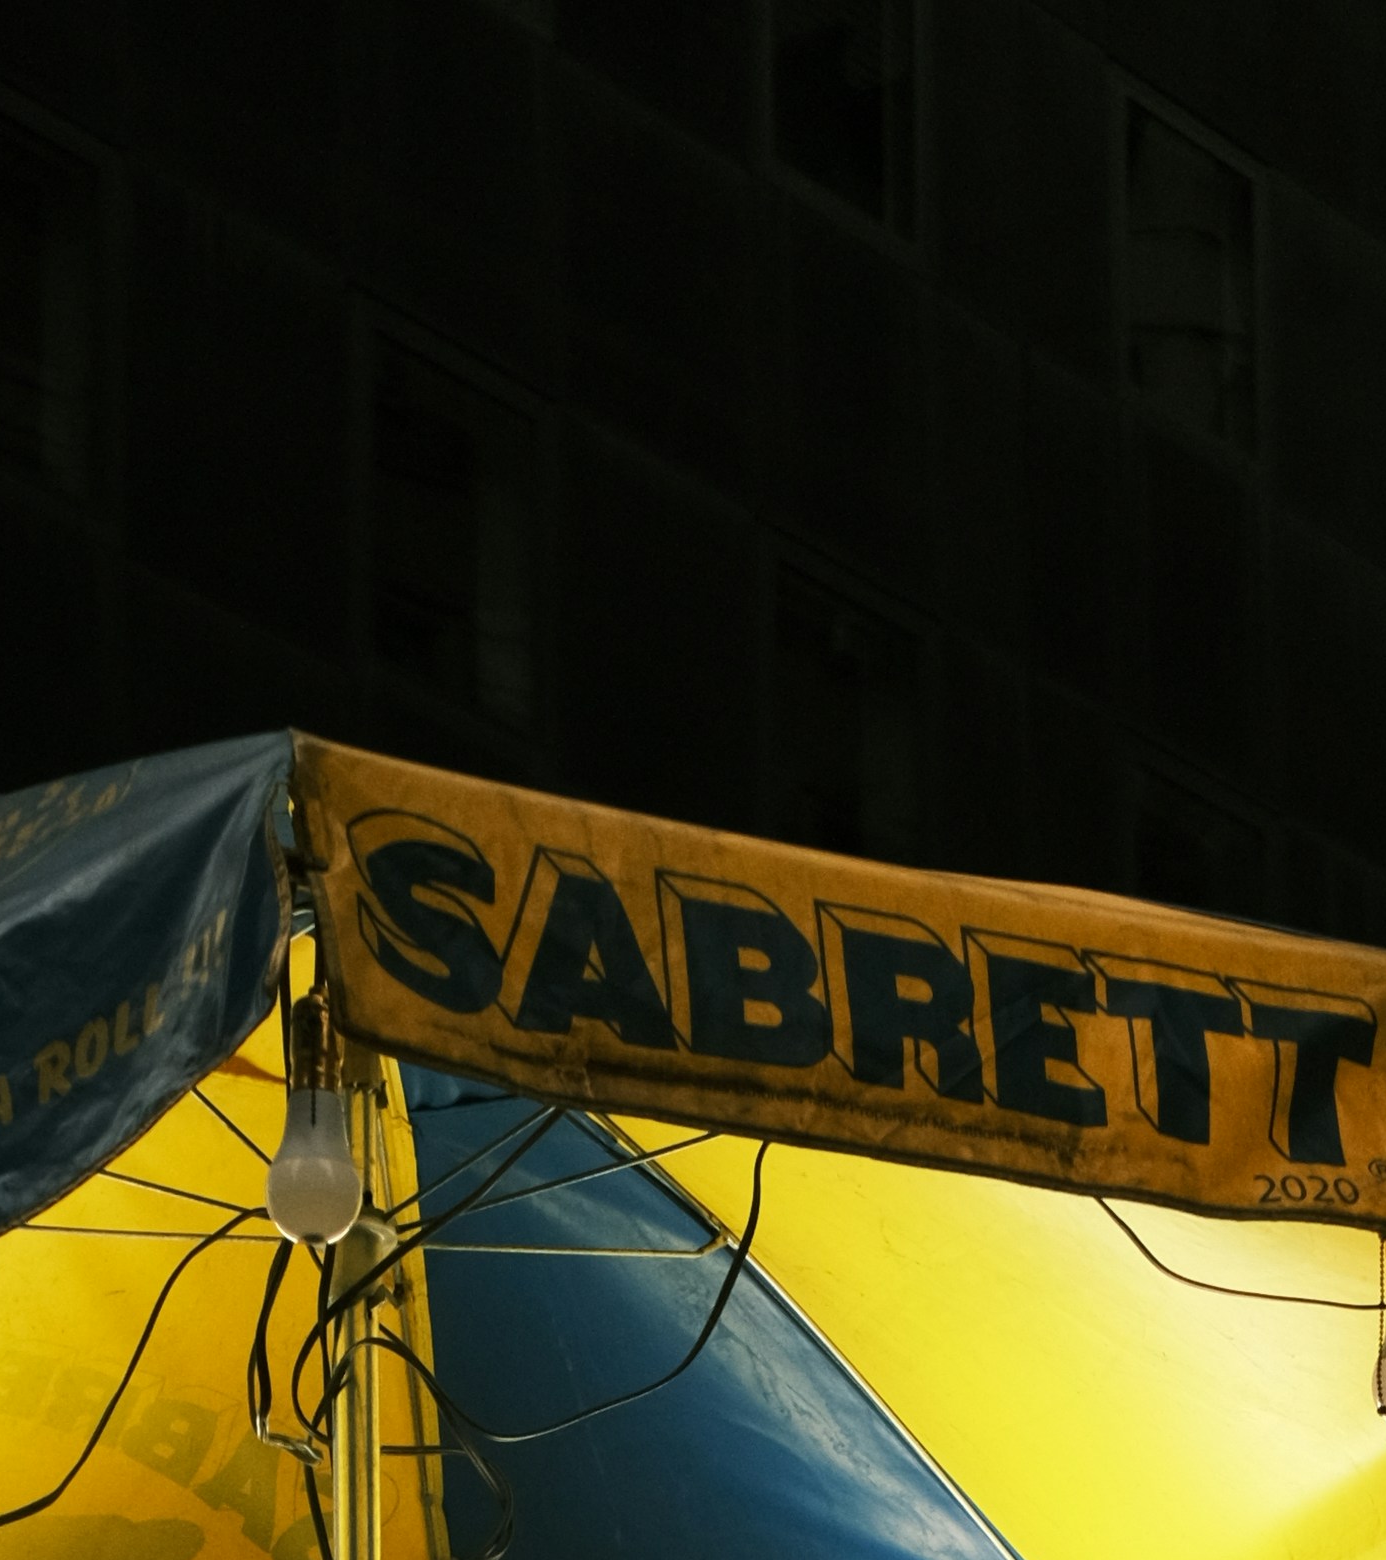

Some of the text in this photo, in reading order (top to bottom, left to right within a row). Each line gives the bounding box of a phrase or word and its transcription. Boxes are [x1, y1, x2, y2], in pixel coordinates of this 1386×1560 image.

[33, 982, 166, 1101] ROLL
[350, 807, 1376, 1167] SABRETT
[1257, 1173, 1361, 1206] 2020
